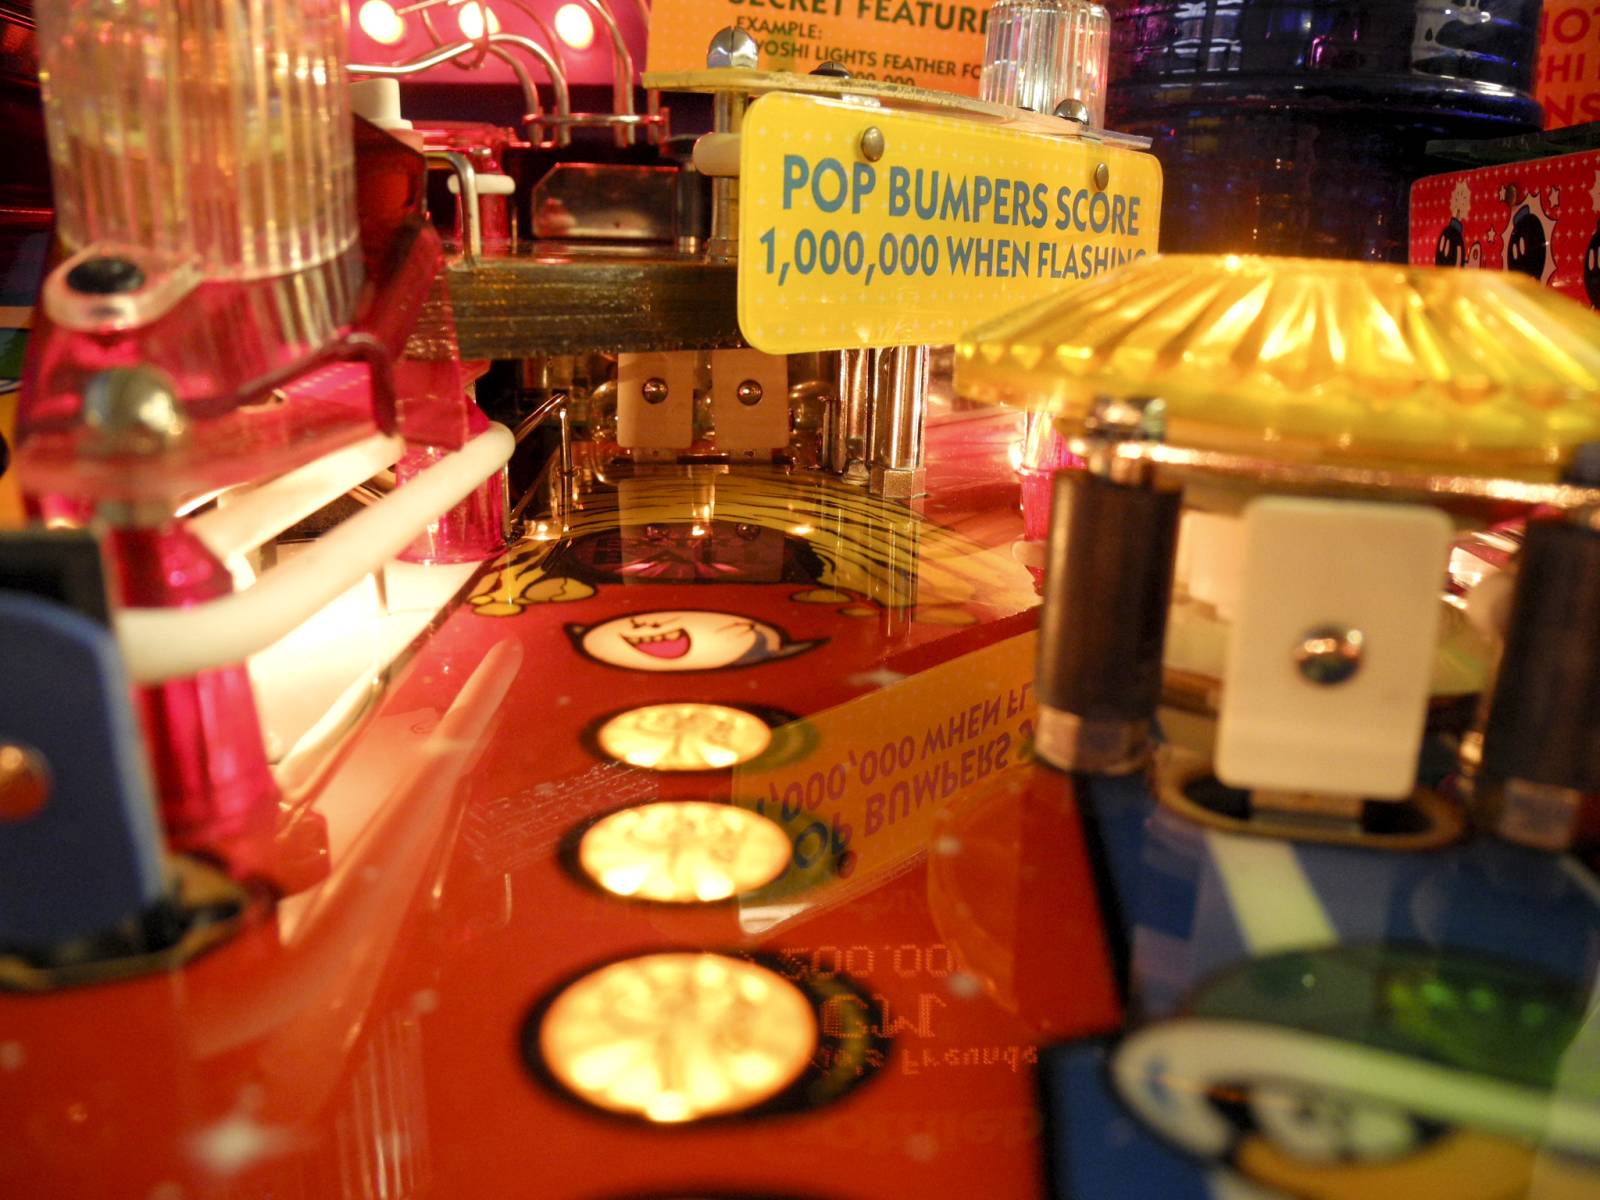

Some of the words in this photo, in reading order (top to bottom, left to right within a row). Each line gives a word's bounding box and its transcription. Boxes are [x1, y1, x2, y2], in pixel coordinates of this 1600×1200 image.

[736, 15, 823, 40] EXAMPLE:
[815, 44, 878, 68] LIGHTS
[883, 53, 957, 76] FEATHER
[782, 153, 876, 214] POP
[888, 165, 1048, 229] BUMPERS
[1055, 185, 1141, 236] SCORE
[759, 226, 939, 286] 1,000,000
[946, 236, 1030, 278] WHEN
[1037, 242, 1147, 280] FLASHIN
